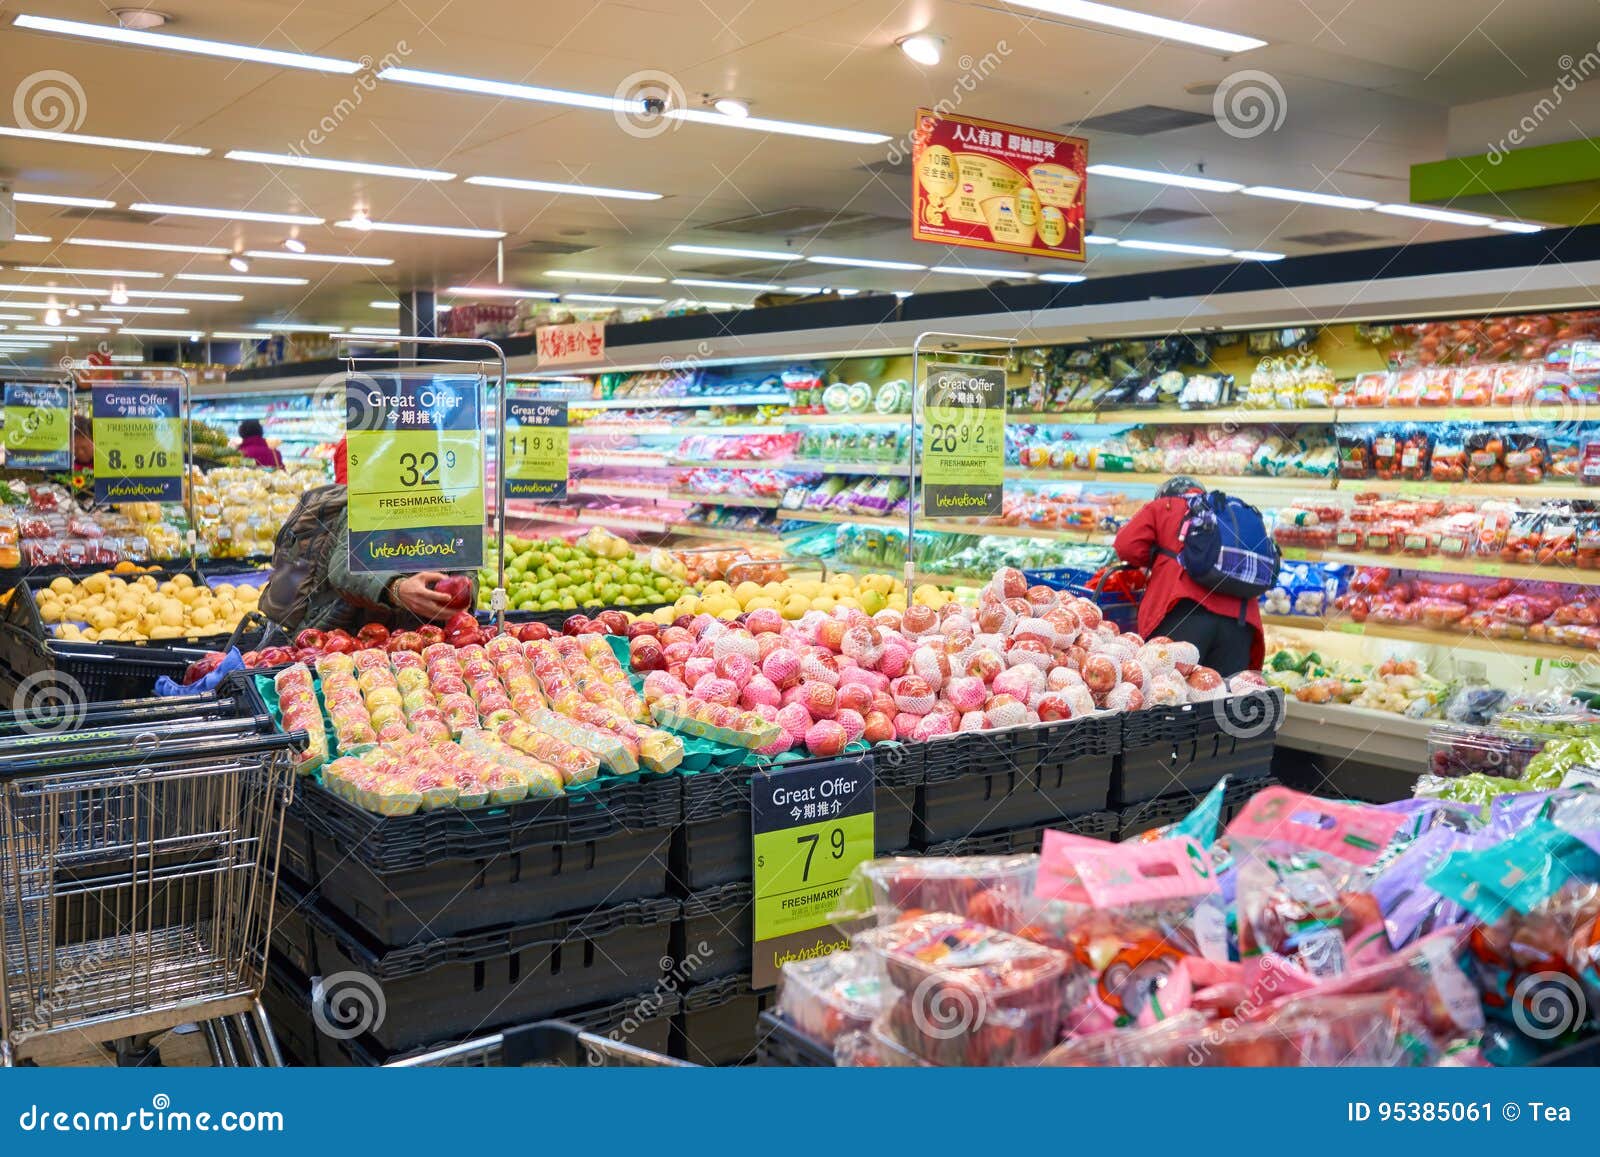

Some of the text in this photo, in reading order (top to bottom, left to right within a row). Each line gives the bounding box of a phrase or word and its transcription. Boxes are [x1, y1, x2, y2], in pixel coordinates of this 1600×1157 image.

[938, 376, 994, 391] Great Offer
[105, 393, 168, 405] Great Offer
[367, 391, 463, 408] Great Offer
[948, 392, 984, 403] 今期推介
[117, 405, 156, 415] 今期推介
[386, 410, 446, 425] 今期推介
[511, 405, 559, 417] Great Offer
[379, 495, 457, 508] FRESHMARKET
[936, 494, 987, 507] International
[370, 538, 456, 559] International
[772, 778, 858, 806] Great Offer
[789, 799, 842, 822] 今期推介
[797, 832, 819, 882] 7
[830, 827, 845, 860] 9
